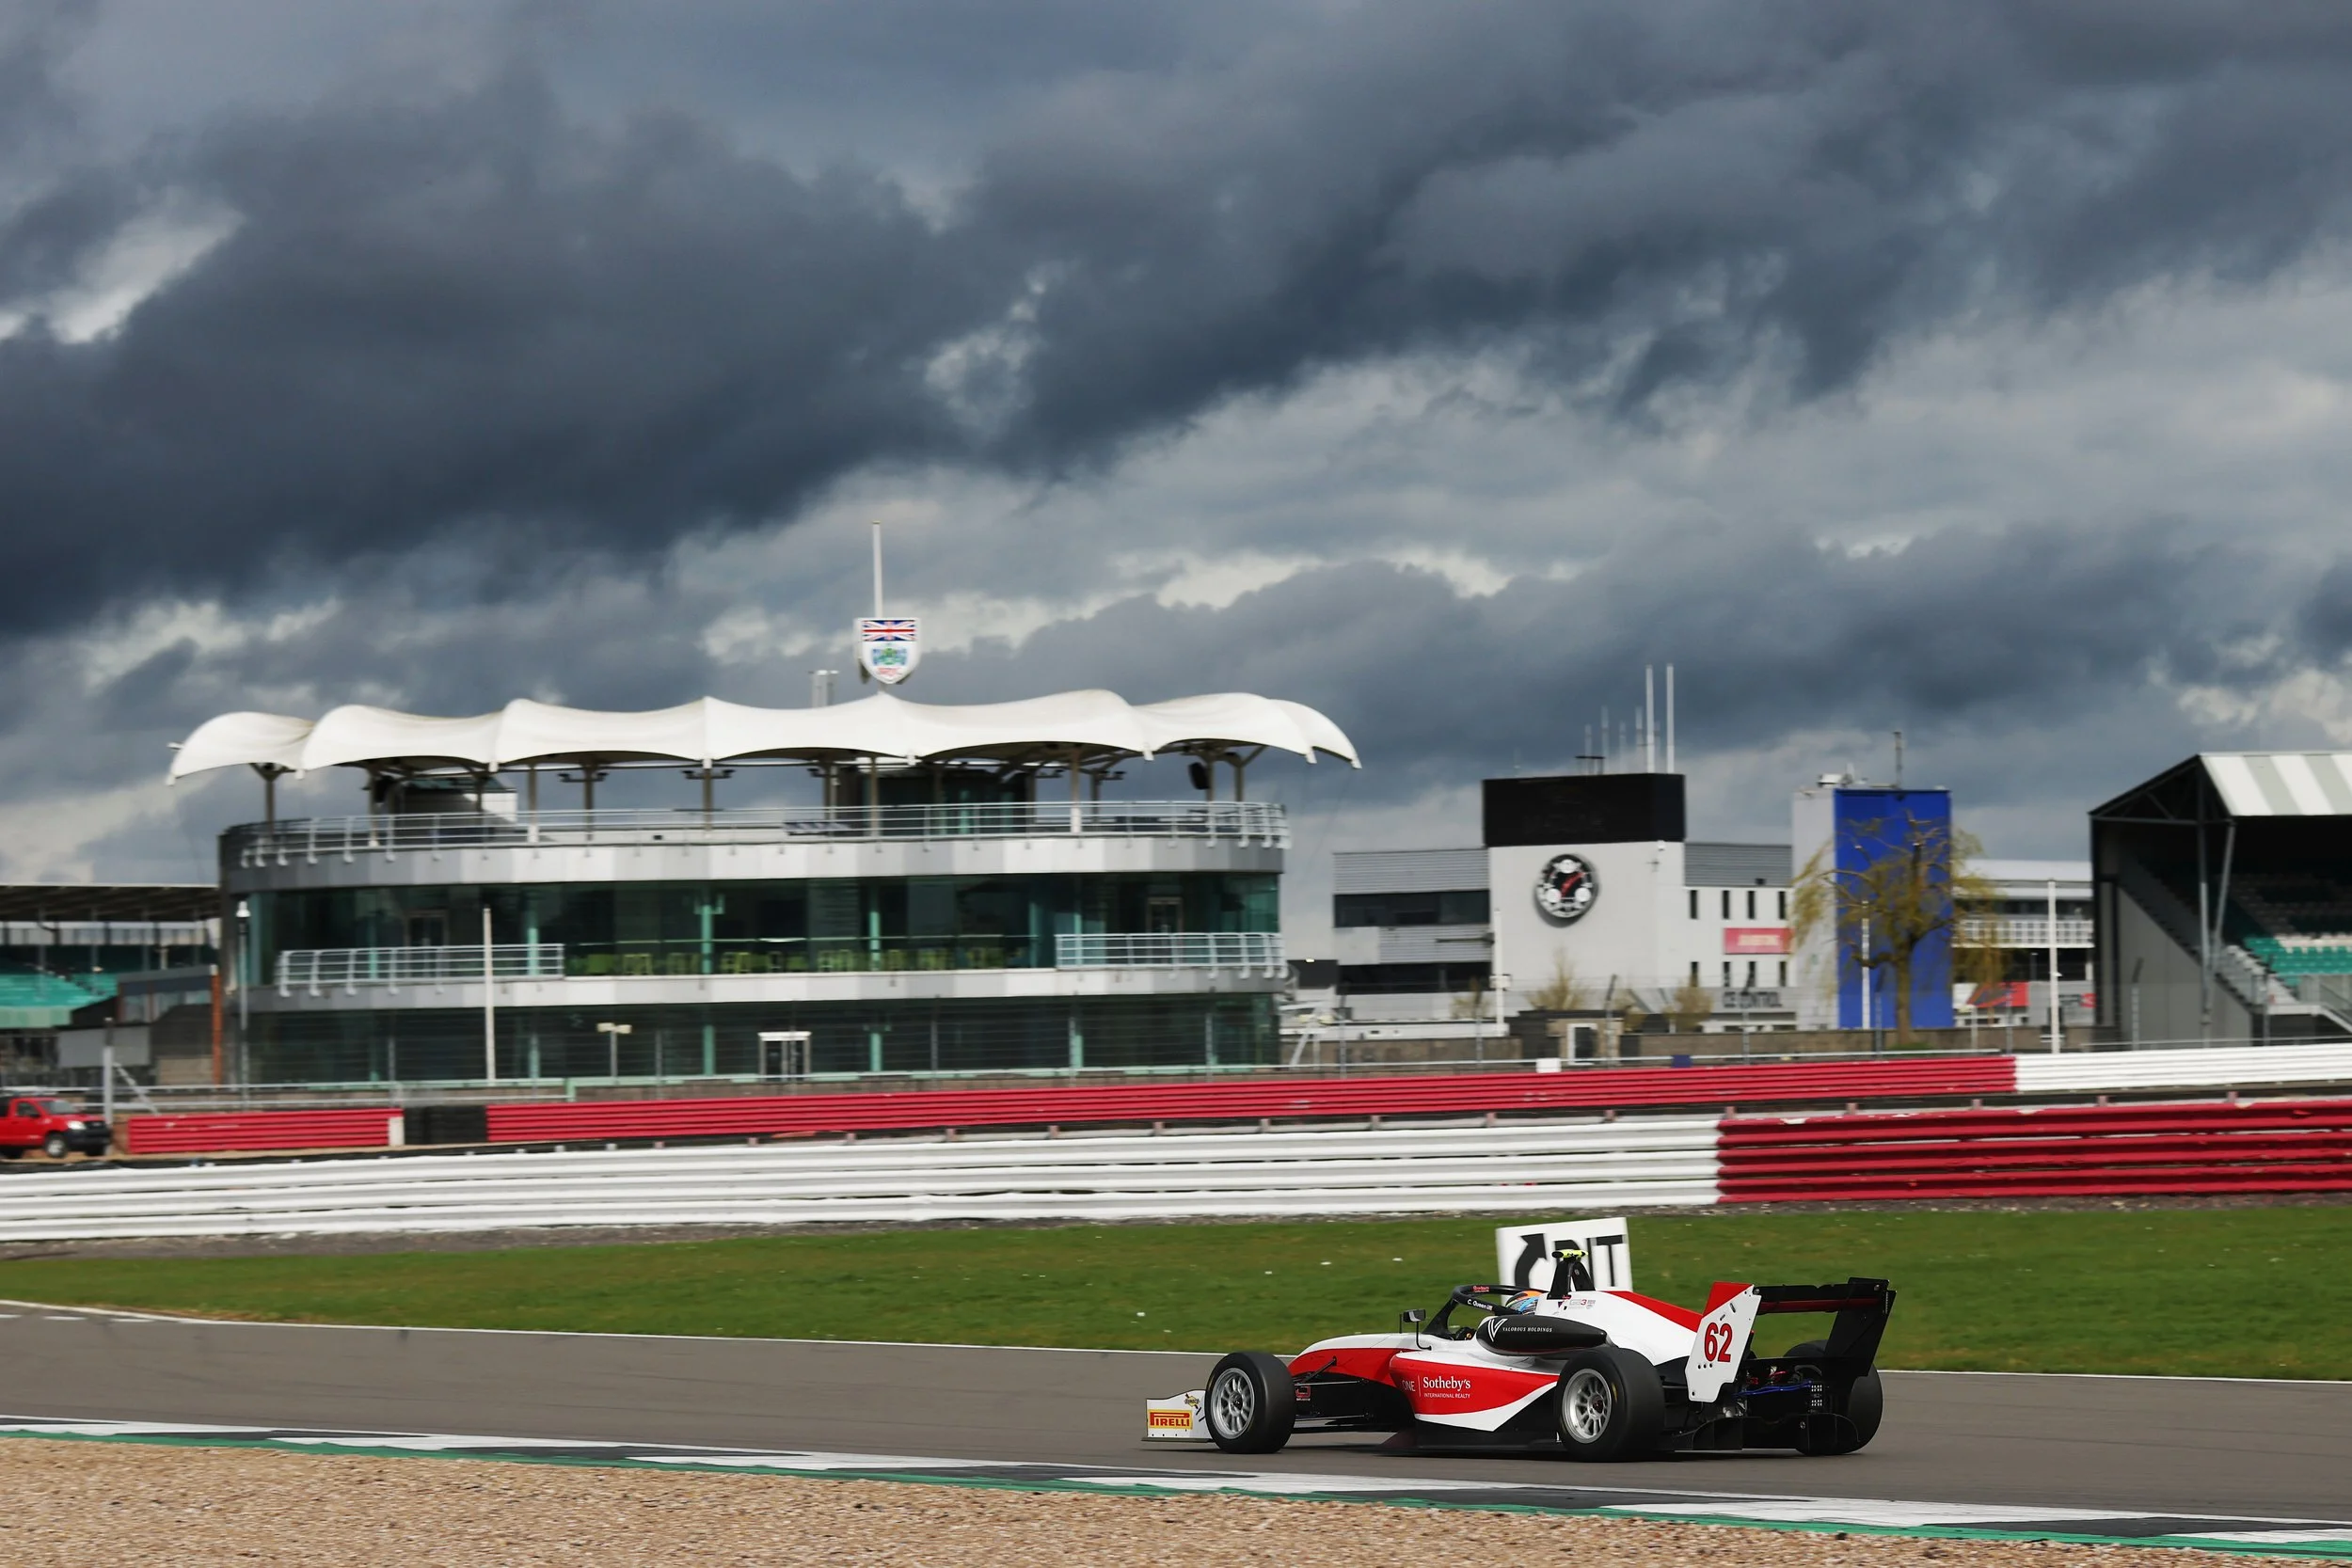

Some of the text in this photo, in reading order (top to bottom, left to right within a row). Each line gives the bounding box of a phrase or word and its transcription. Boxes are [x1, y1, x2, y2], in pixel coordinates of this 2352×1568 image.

[1704, 1322, 1733, 1363] 62
[1422, 1375, 1471, 1392] Sotheby's
[1150, 1412, 1190, 1427] PIRELLI
